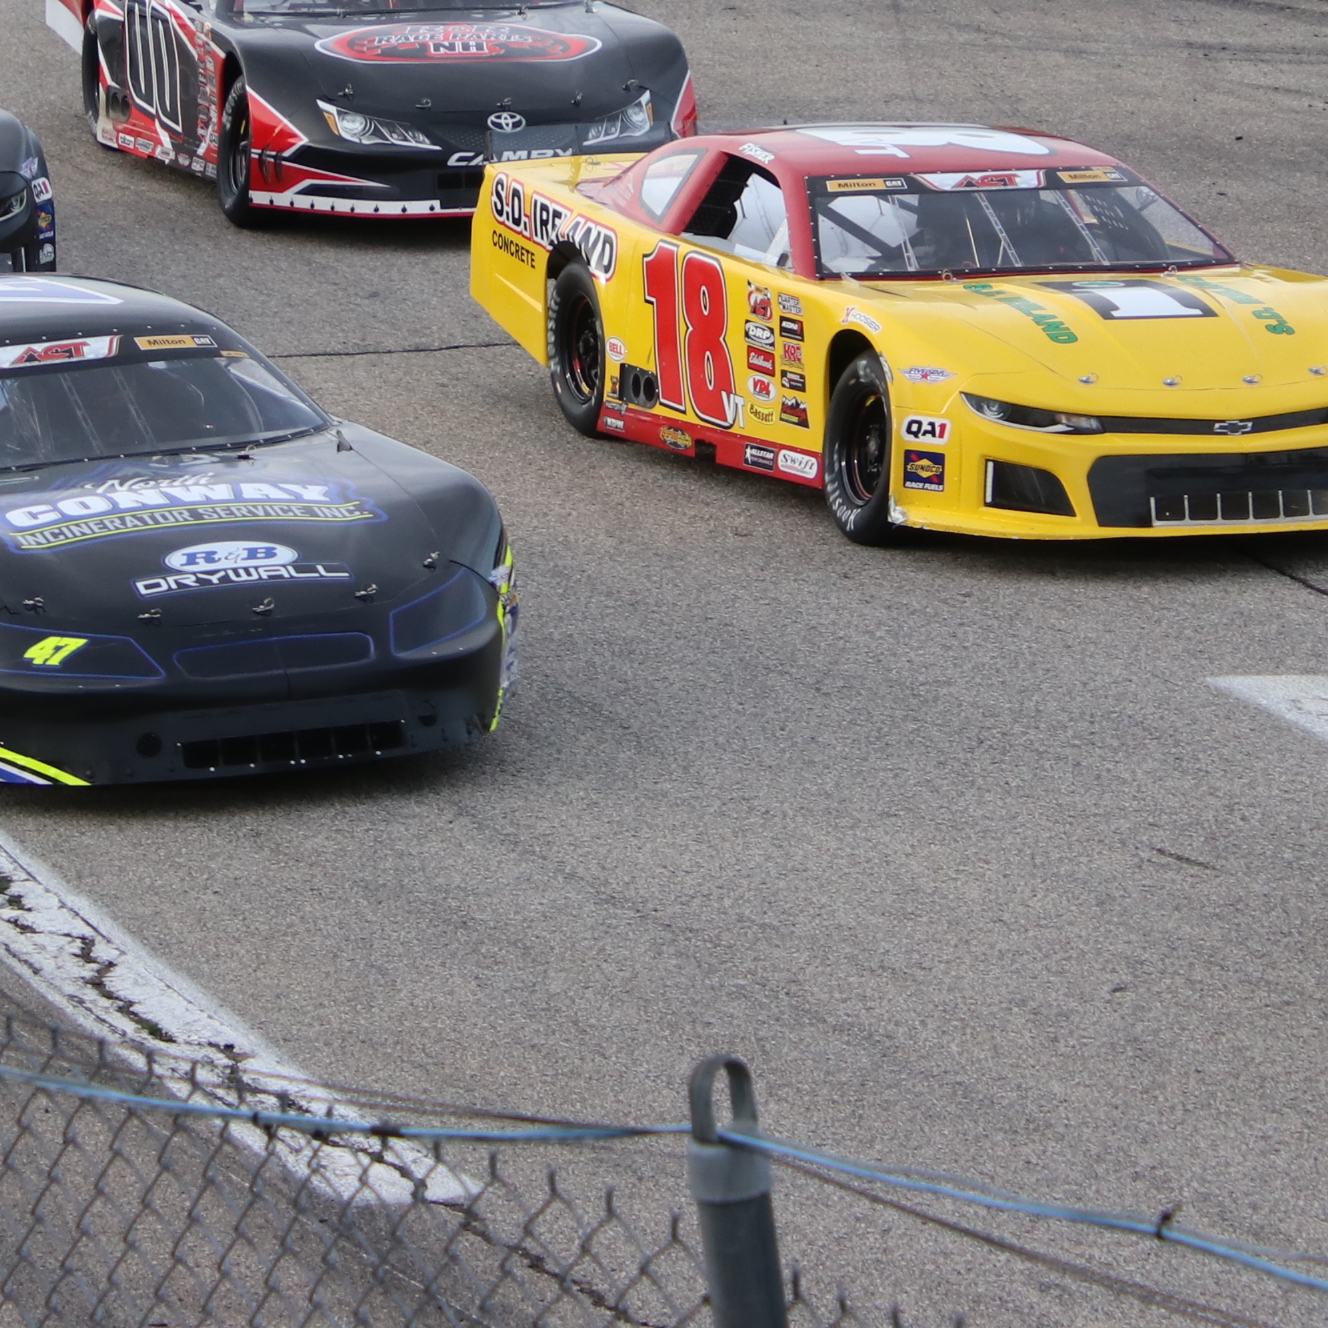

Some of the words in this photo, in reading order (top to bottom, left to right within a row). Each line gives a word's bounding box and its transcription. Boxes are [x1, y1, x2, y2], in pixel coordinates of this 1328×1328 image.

[430, 40, 487, 54] NH
[837, 181, 876, 190] Milton
[951, 175, 1021, 188] ACT
[492, 172, 530, 238] S.D.
[531, 190, 617, 282] IRELAND
[492, 230, 536, 270] CONCRETE
[147, 336, 187, 347] Milton
[643, 240, 737, 430] 18
[749, 326, 770, 339] DRP
[11, 341, 90, 365] ACT
[609, 342, 624, 355] BELL
[722, 391, 746, 428] VT
[749, 403, 774, 422] Bassett
[906, 419, 947, 439] QA1
[780, 453, 815, 471] Swift
[908, 462, 941, 473] SUNOCO
[905, 481, 923, 489] RACE
[5, 481, 334, 528] CONWAY
[17, 509, 191, 548] INCINERATOR
[197, 504, 311, 523] SERVICE
[314, 503, 372, 519] INC.
[179, 545, 278, 568] R&B
[135, 564, 350, 596] DRYWALL
[24, 636, 89, 666] 47
